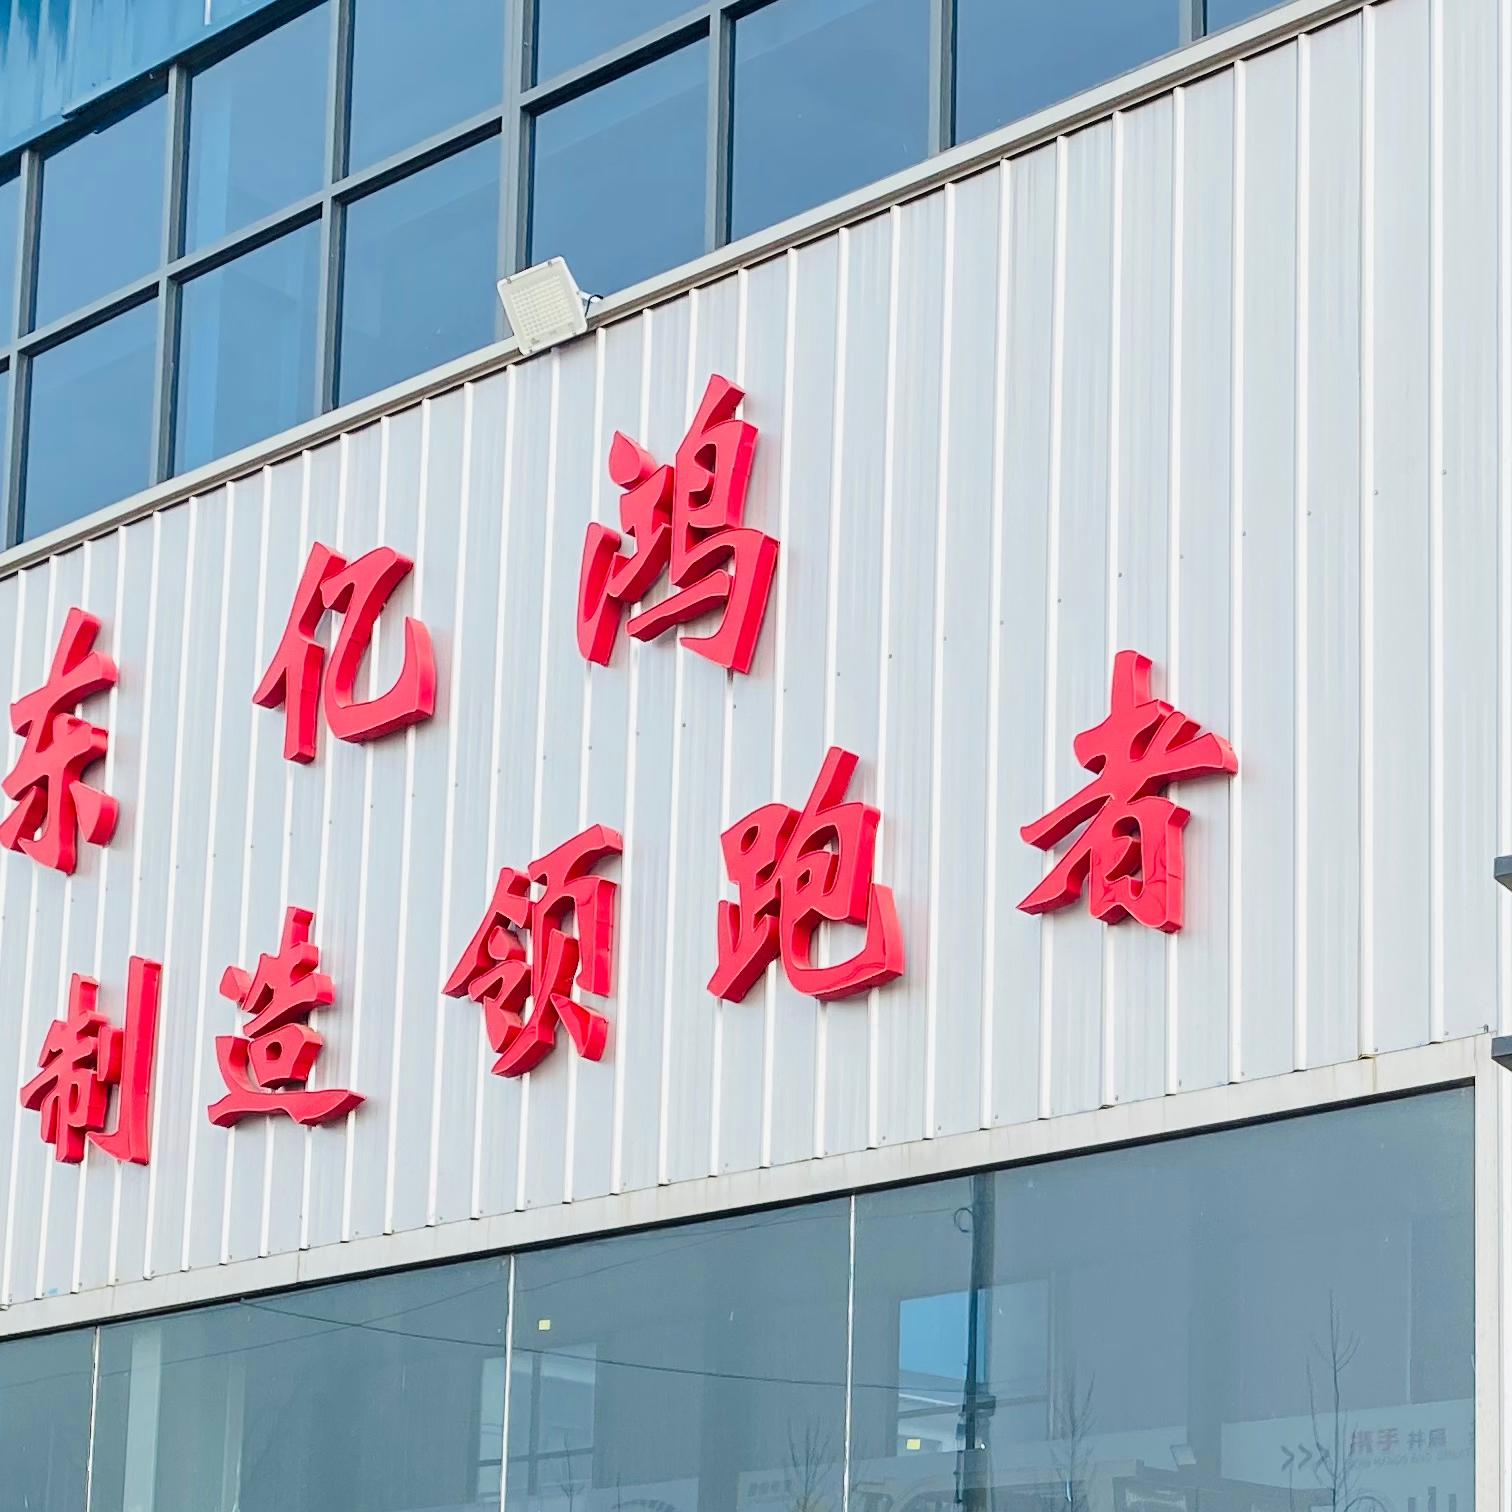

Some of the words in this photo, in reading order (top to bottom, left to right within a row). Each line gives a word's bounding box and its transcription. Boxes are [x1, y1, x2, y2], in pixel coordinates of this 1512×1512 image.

[0, 374, 780, 875] 东亿鸿
[20, 649, 1239, 1165] 制造领跑者
